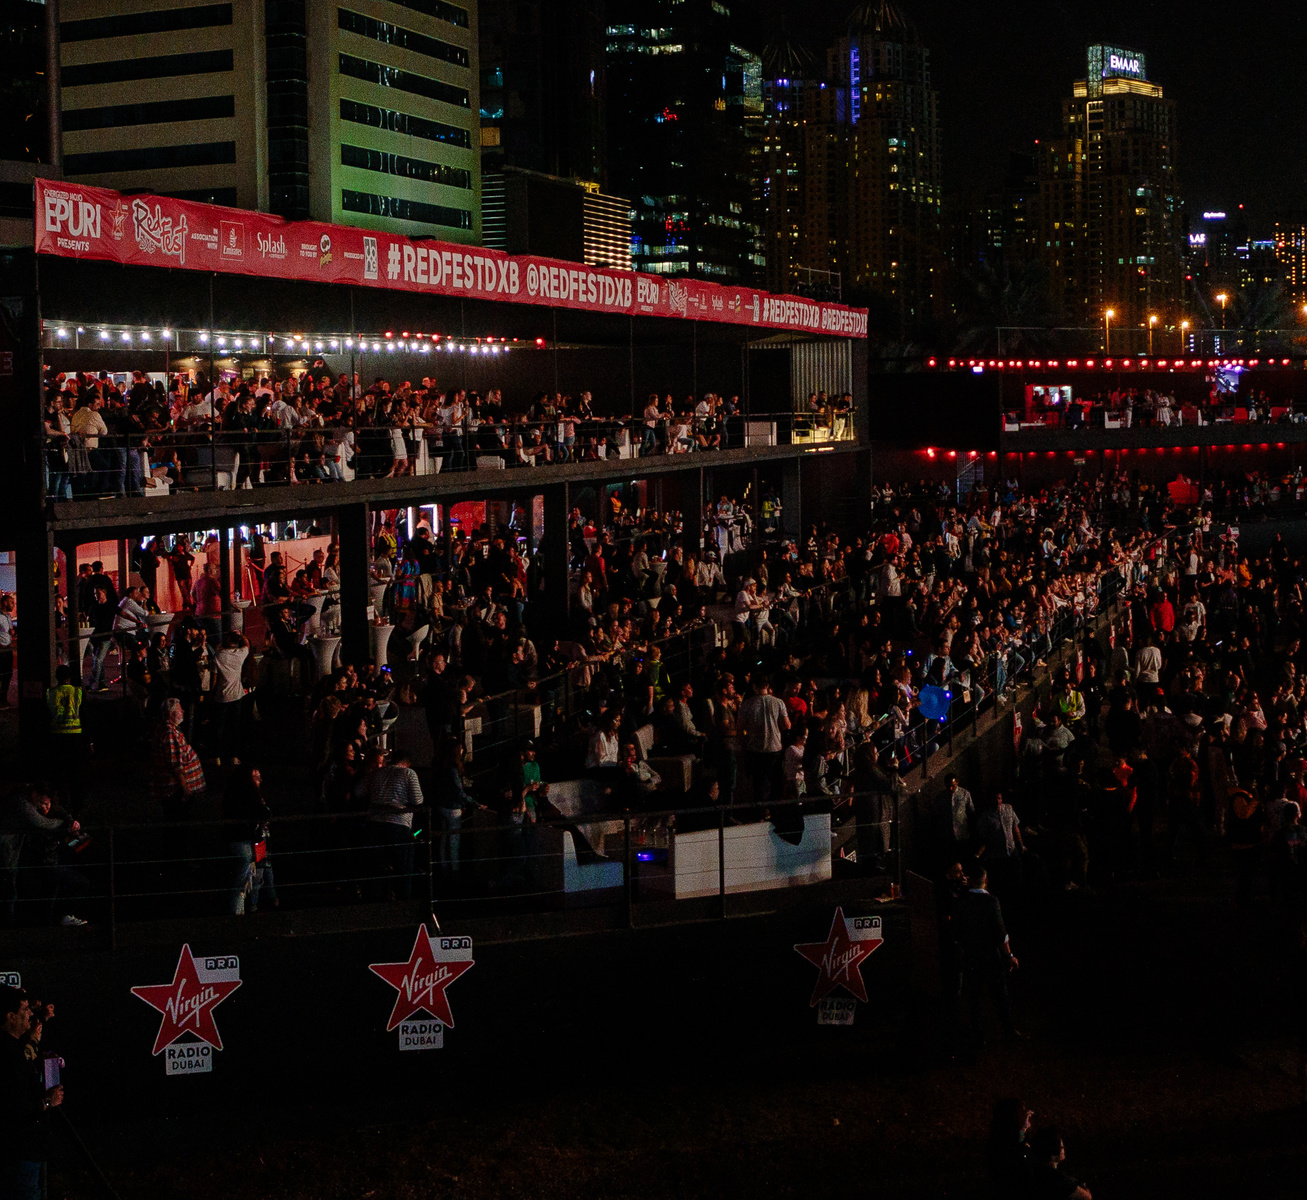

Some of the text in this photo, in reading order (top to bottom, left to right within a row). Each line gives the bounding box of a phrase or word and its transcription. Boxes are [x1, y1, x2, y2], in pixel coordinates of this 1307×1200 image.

[1110, 55, 1140, 73] EMAAR
[45, 196, 102, 238] EPURI
[57, 237, 90, 252] PRESENTS
[223, 245, 242, 256] Emirates
[257, 232, 285, 258] Splash
[388, 243, 519, 294] #REDFESTDXB
[526, 263, 632, 308] @REDFESTDXB
[637, 281, 659, 305] EPURI
[763, 298, 819, 328] #REDFESTDXB
[821, 937, 865, 981] Virgin
[401, 958, 452, 1005] Virgin
[165, 979, 219, 1027] Virgin
[820, 1001, 855, 1011] RADIO
[401, 1023, 442, 1036] RADIO
[405, 1036, 436, 1046] DUBAI
[168, 1046, 211, 1060] RADIO
[171, 1060, 205, 1071] DUBAI
